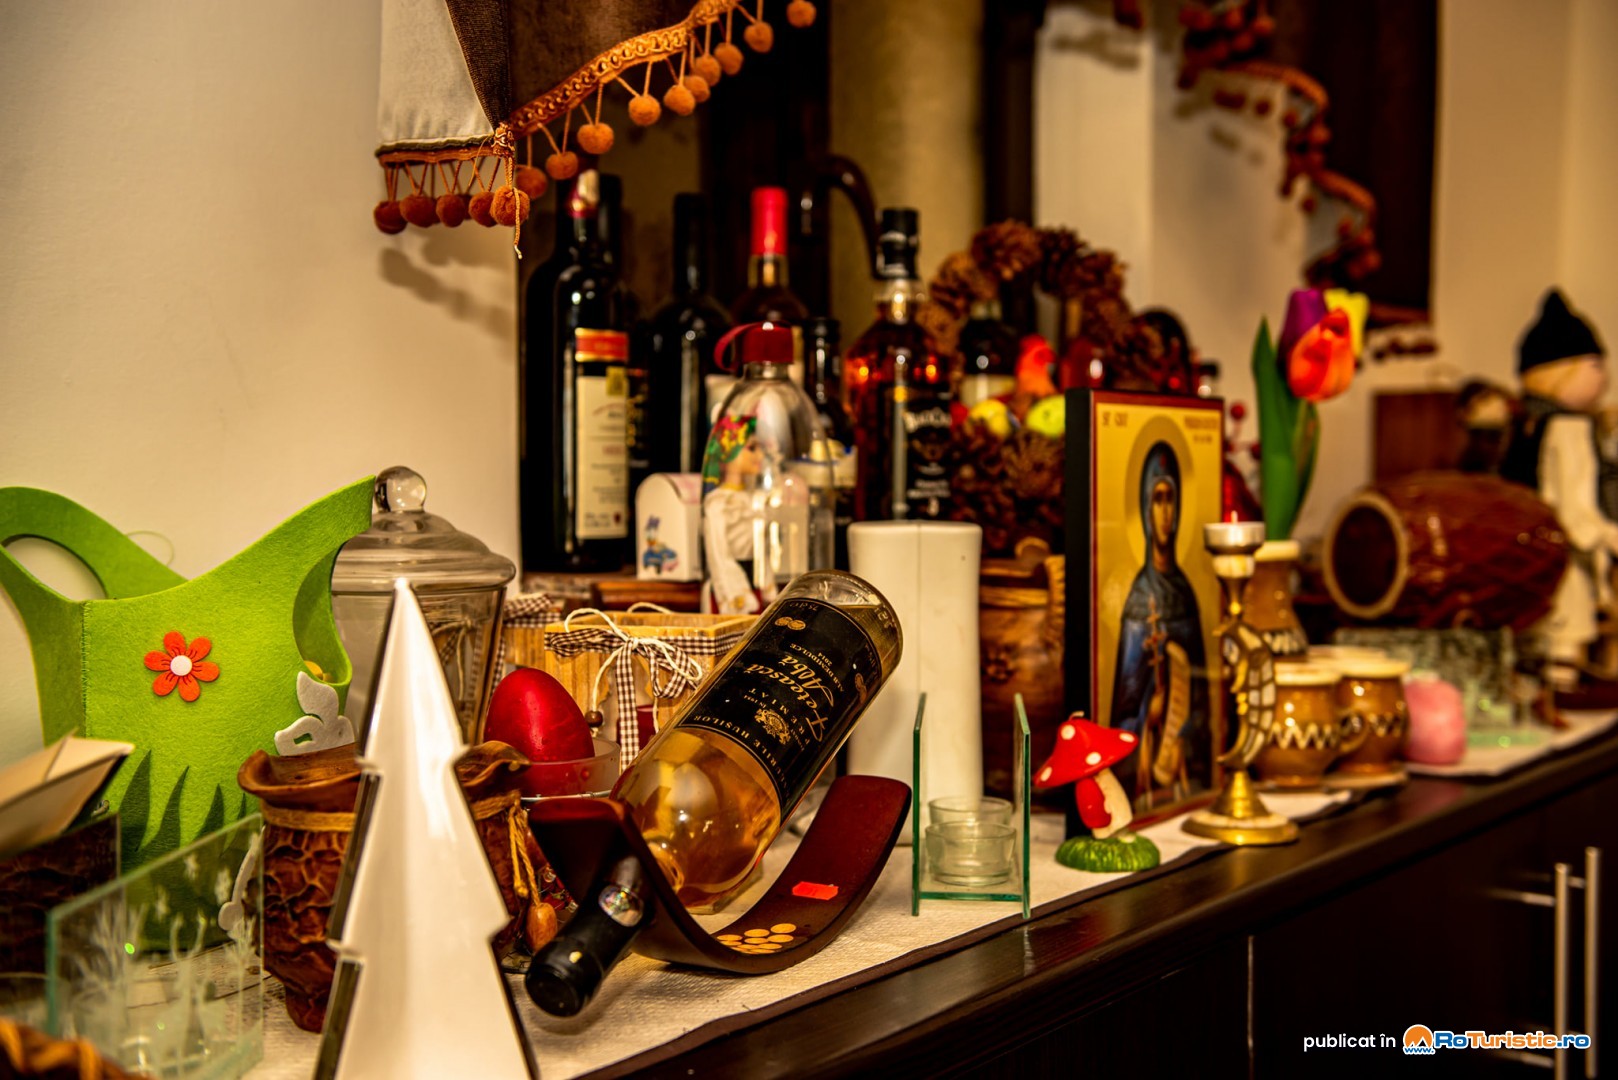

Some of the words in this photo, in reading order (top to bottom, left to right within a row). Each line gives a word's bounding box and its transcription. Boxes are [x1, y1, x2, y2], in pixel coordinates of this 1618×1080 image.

[778, 655, 834, 707] Albă
[789, 643, 835, 677] DEMIDULCE
[817, 652, 833, 667] 2014
[743, 663, 829, 742] Fetească
[833, 676, 844, 693] ALB
[748, 688, 811, 745] PREMIAT
